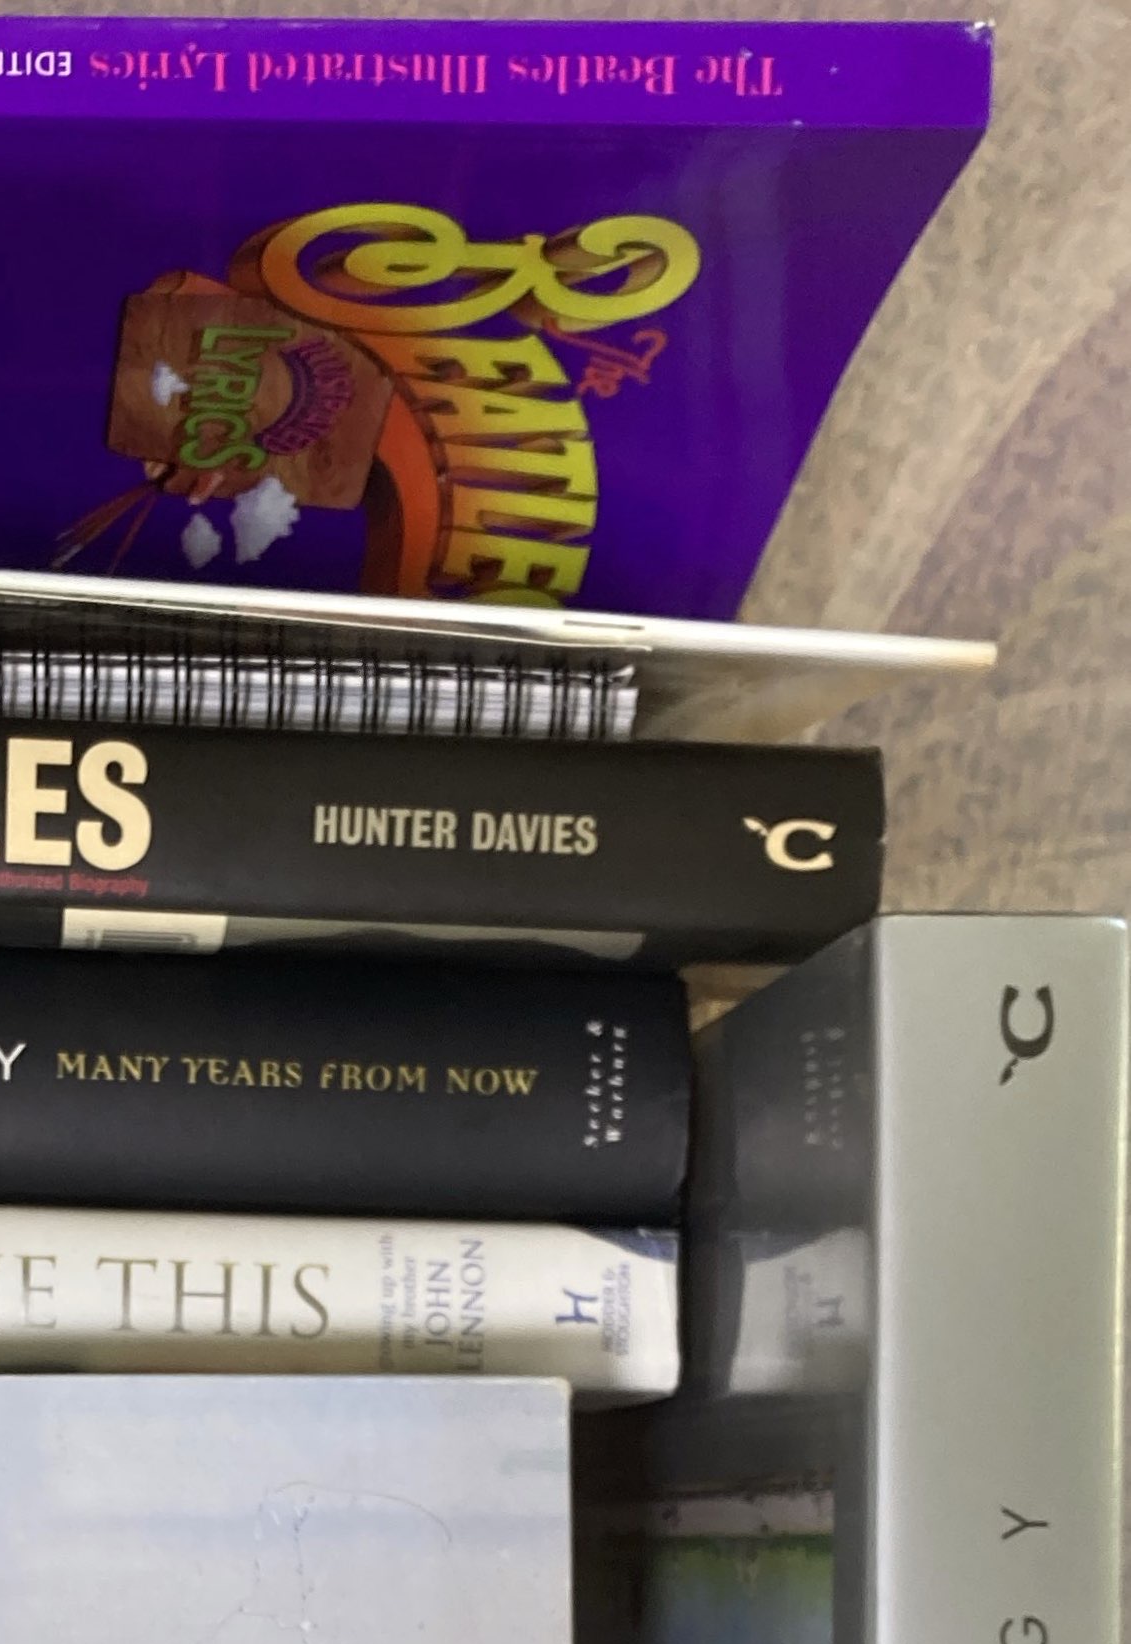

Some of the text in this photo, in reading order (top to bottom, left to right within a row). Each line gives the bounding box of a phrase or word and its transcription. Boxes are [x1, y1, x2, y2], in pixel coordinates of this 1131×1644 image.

[90, 42, 231, 92] Lyrics
[247, 51, 489, 93] Illustrated
[507, 52, 677, 95] Beatles
[695, 54, 783, 96] The
[544, 320, 666, 400] The
[178, 324, 296, 471] LYRICS
[313, 805, 599, 857] HUNTER DAVIES
[69, 871, 149, 897] Biography
[56, 1052, 539, 1097] MANY YEARS FROM NOW
[95, 1255, 333, 1342] THIS
[378, 1234, 398, 1369] growing up with
[401, 1256, 420, 1350] my brother
[425, 1259, 453, 1346] JOHN
[459, 1238, 486, 1371] LENNON
